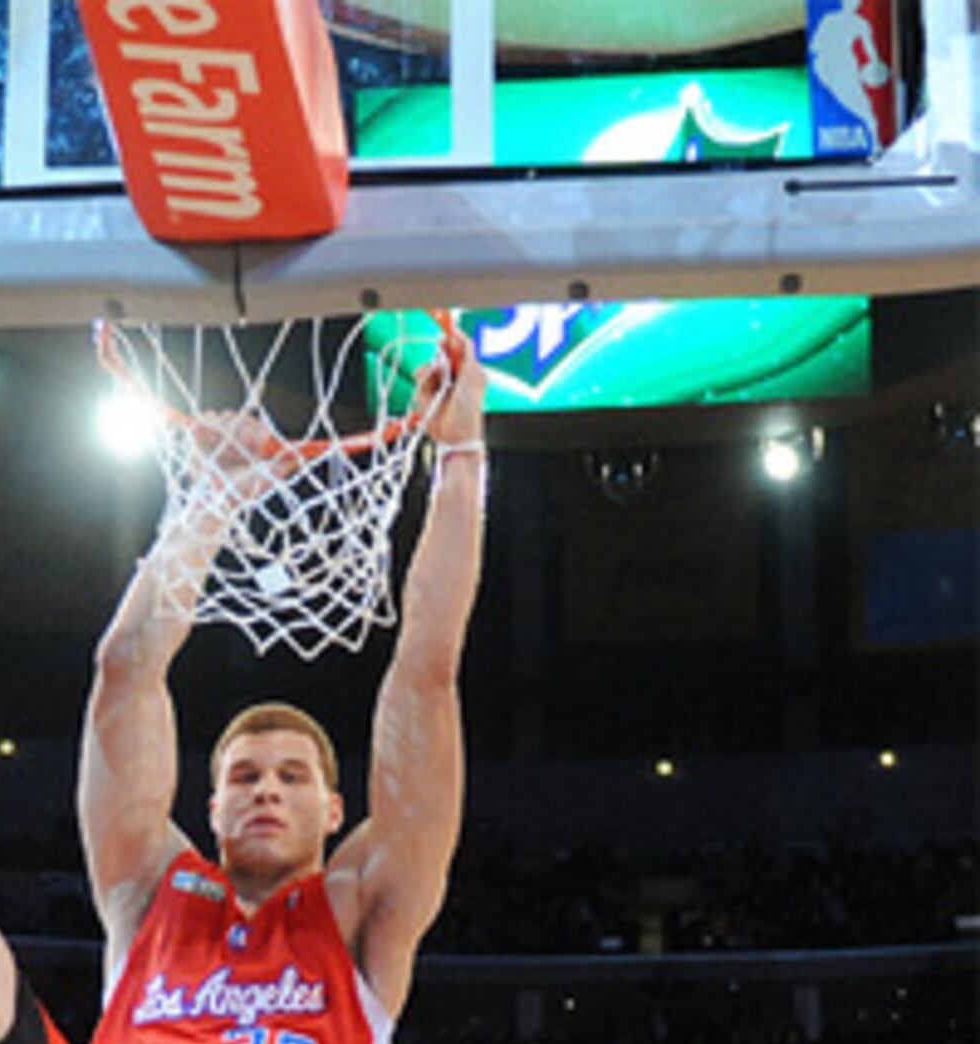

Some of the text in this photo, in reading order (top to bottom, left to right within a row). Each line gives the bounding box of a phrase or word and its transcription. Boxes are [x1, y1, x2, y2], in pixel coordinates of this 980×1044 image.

[119, 41, 264, 221] Farm
[131, 966, 325, 1027] Los Angeles
